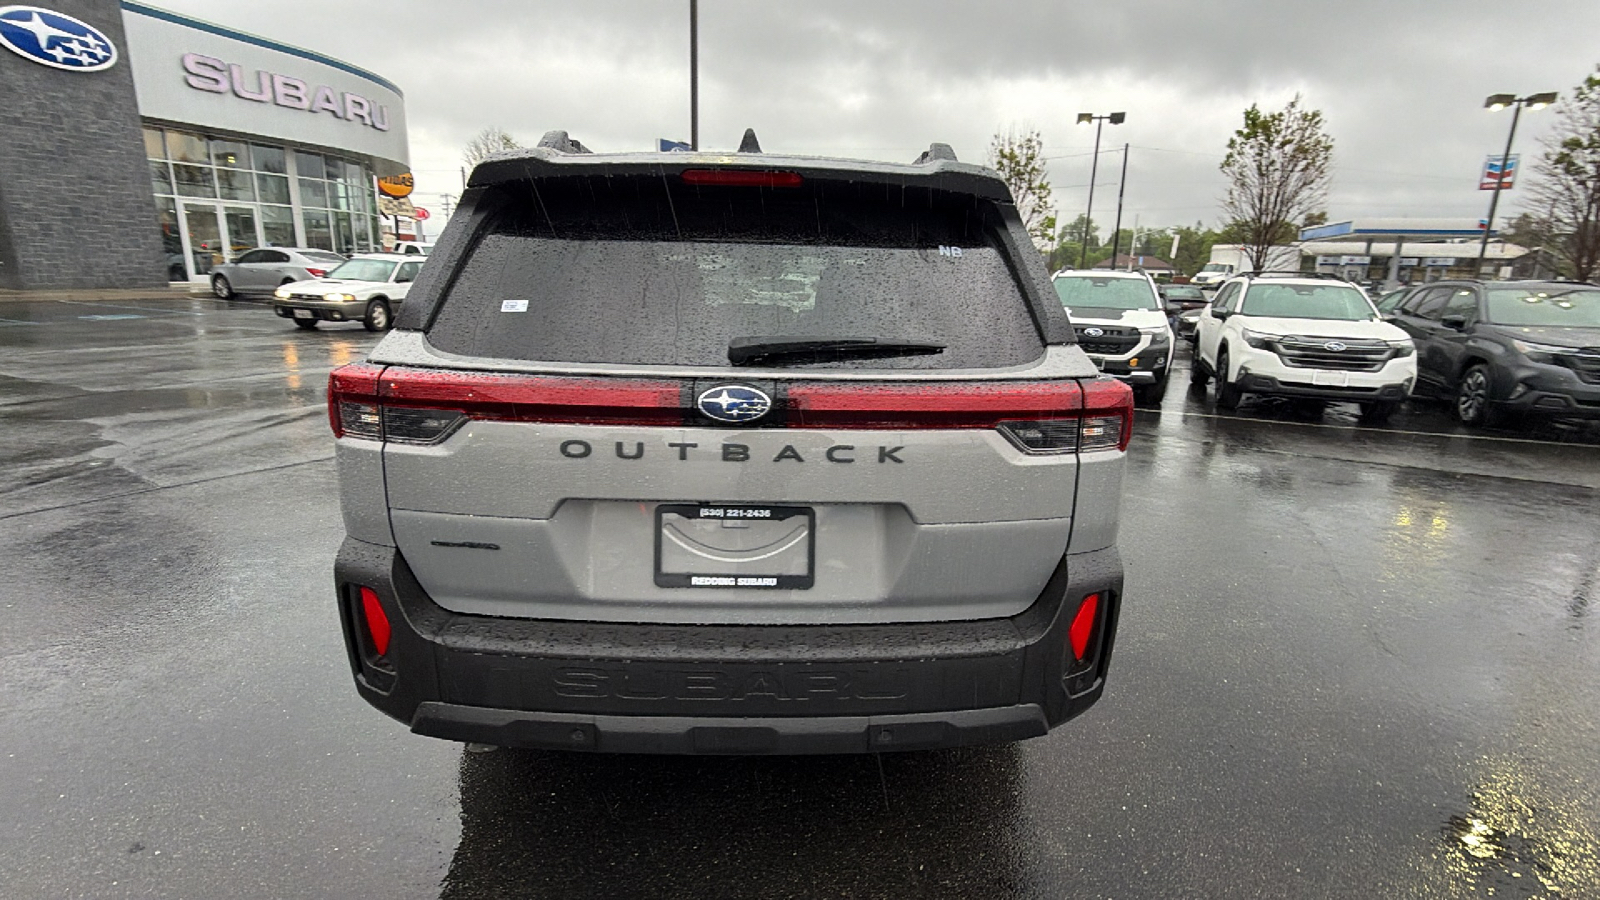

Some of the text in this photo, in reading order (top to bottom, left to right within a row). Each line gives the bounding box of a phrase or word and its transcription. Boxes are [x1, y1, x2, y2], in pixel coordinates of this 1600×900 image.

[182, 53, 390, 132] SUBARU
[560, 439, 905, 464] OUTBACK
[691, 577, 777, 587] REDDING SUBARU
[553, 667, 908, 701] SUBARU
